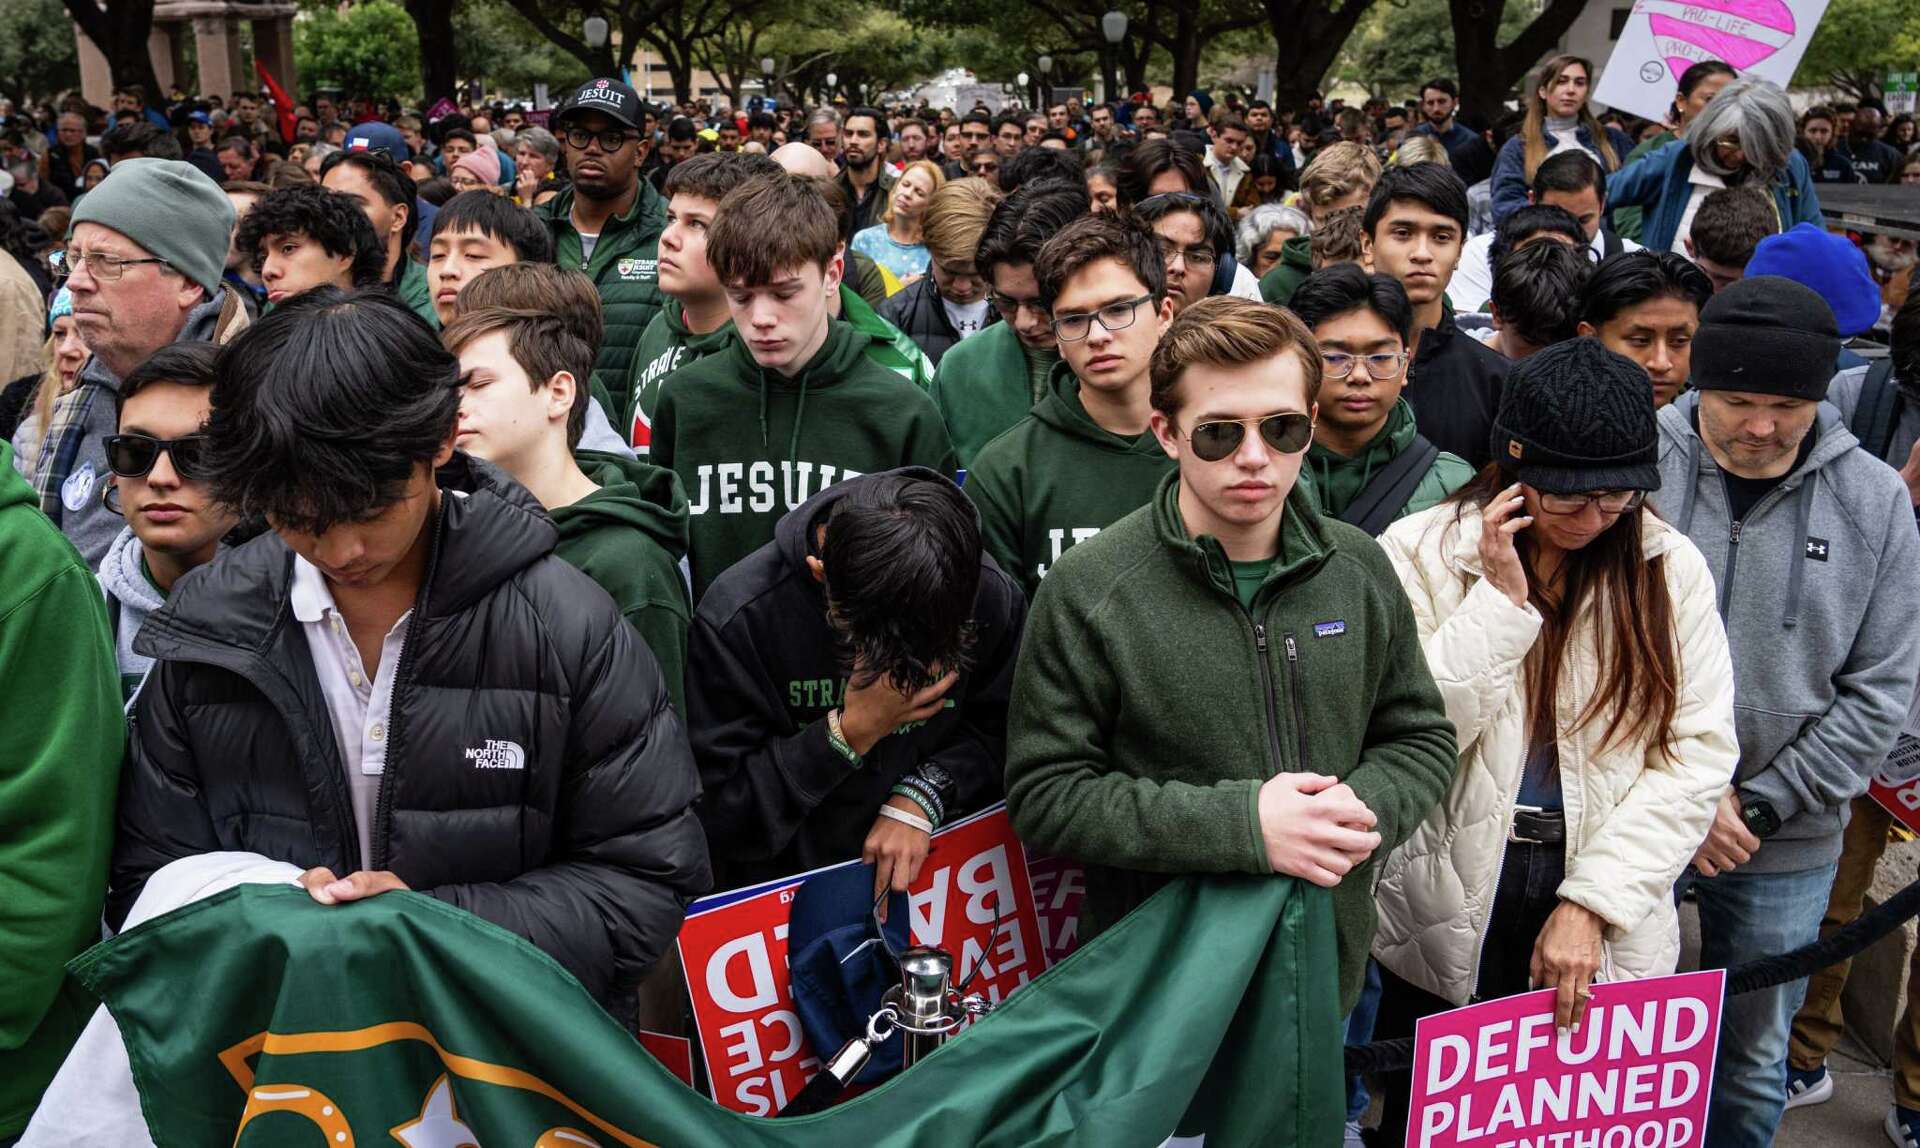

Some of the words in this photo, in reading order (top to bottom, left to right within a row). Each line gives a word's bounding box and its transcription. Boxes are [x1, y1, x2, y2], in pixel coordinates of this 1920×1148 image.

[1682, 6, 1750, 37] PRO-LIFE
[578, 88, 625, 104] JESUIT
[485, 739, 508, 750] THE
[465, 747, 506, 760] NORTH
[475, 759, 506, 769] FACE
[1426, 996, 1710, 1096] DEFUND
[1418, 1060, 1701, 1148] PLANNED
